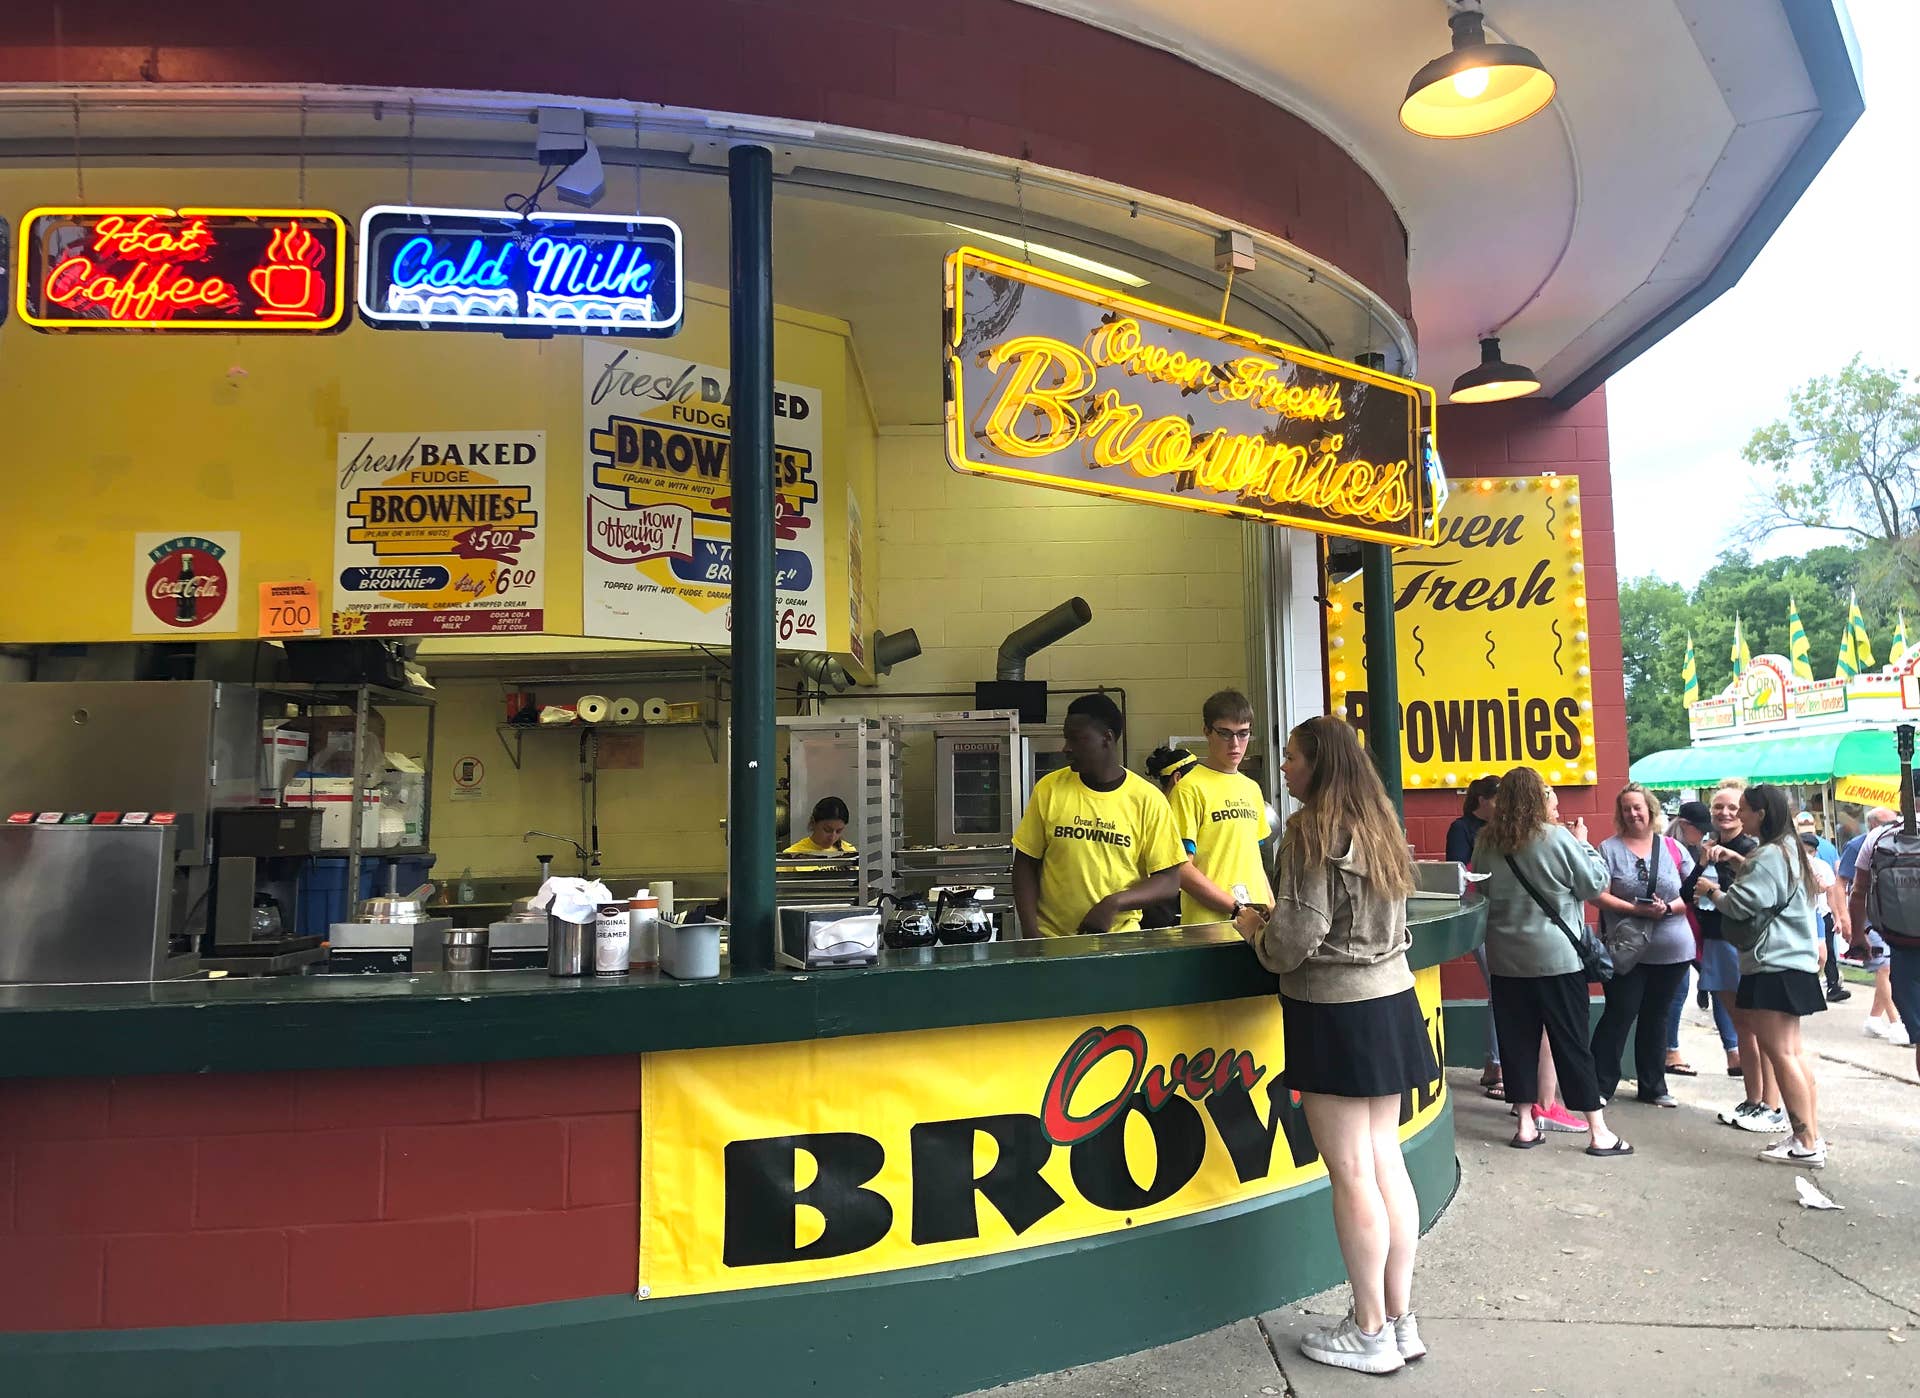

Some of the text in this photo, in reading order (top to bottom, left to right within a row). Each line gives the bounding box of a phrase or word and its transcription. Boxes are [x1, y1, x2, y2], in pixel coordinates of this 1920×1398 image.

[93, 215, 208, 253] Hot
[391, 236, 652, 294] Cold Milk
[46, 258, 231, 320] Coffee
[590, 349, 697, 406] fresh
[1105, 317, 1347, 422] Oven Fresh
[983, 334, 1415, 523] Brownies
[339, 436, 537, 490] fresh BAKED
[616, 424, 799, 489] BROWES
[410, 470, 470, 484] FUDGE
[622, 473, 716, 496] (PLAIN OR WITH NUTS)
[370, 493, 516, 524] BROWNIES
[643, 511, 676, 533] now
[603, 580, 634, 591] TOPPED
[637, 584, 659, 593] WITH
[661, 587, 676, 595] HOT
[707, 591, 730, 600] CARAM
[786, 598, 808, 606] CREAM
[269, 606, 310, 626] 700
[388, 619, 413, 627] COFFEE
[1345, 688, 1582, 763] Bownies
[1845, 785, 1897, 804] LEMONADE
[1054, 826, 1131, 848] BROWNIES
[1073, 815, 1116, 830] Oven Fresh
[1040, 1025, 1267, 1147] Oven
